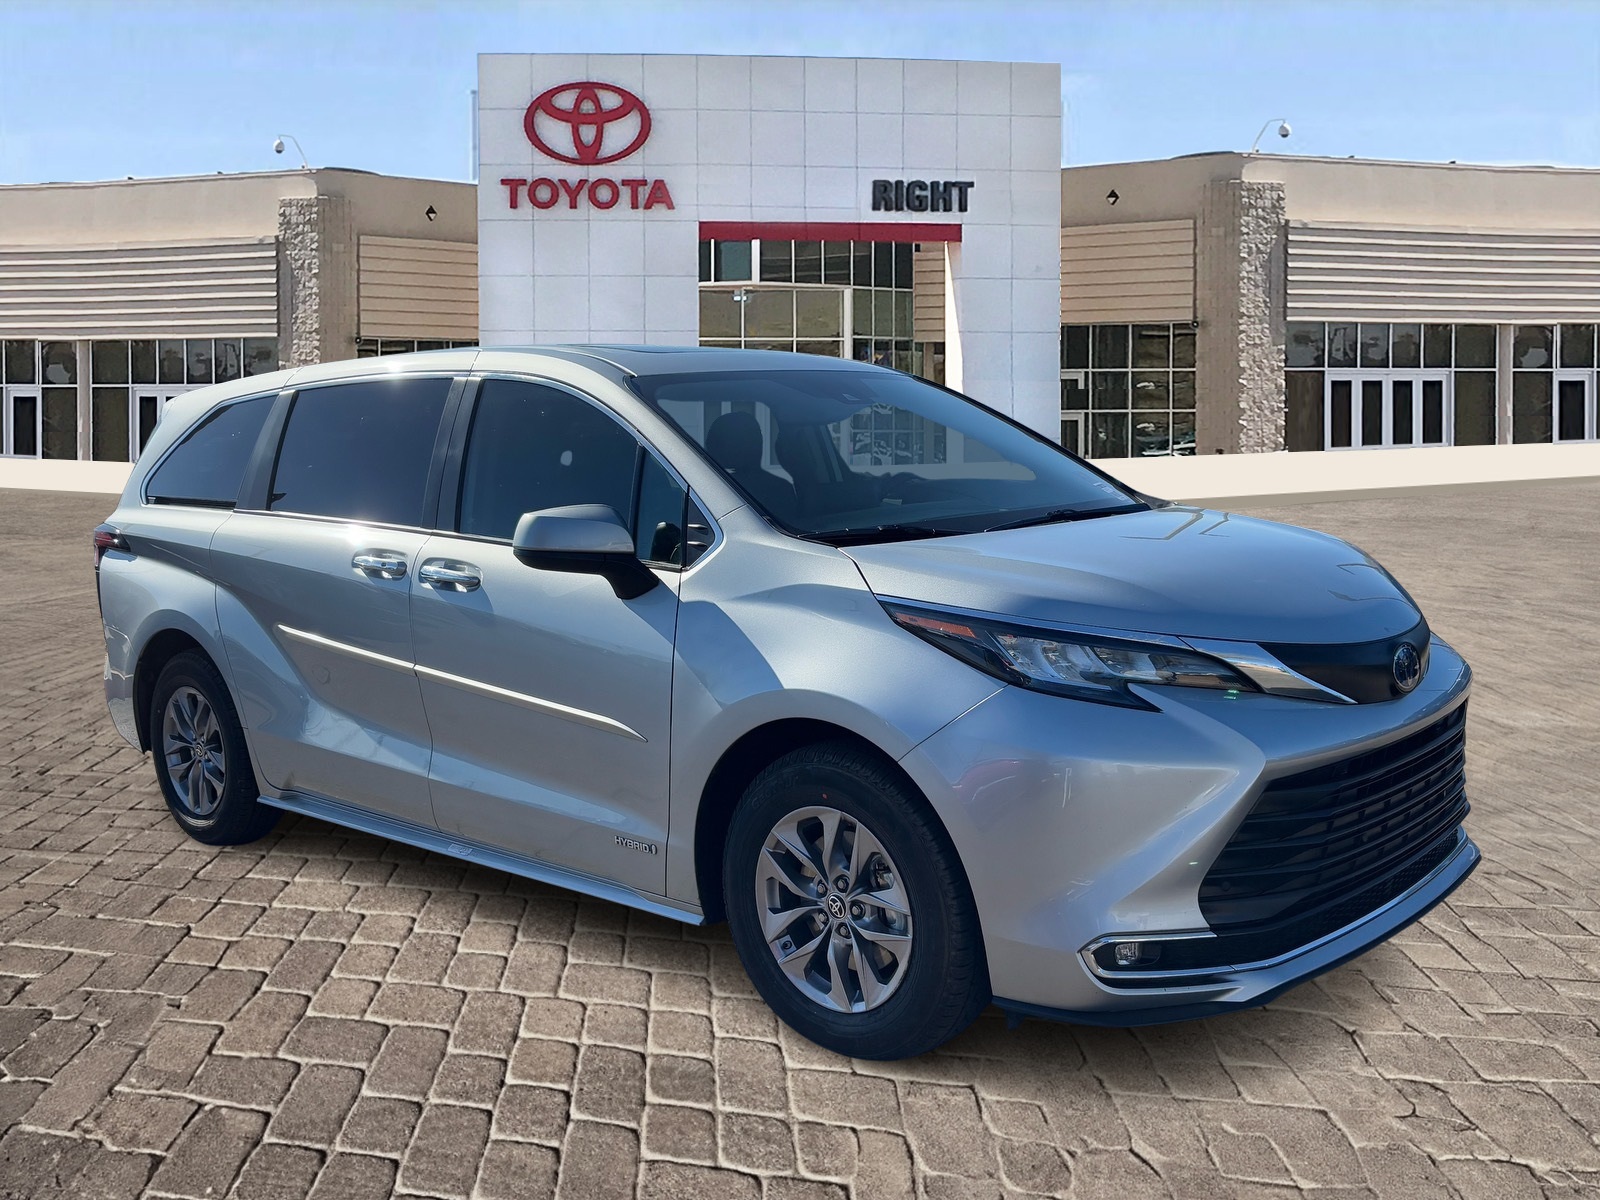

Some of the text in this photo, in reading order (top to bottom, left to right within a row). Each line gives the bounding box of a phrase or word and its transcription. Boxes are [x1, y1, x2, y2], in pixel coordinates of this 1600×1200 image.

[501, 178, 675, 209] TOYOTA
[872, 180, 975, 212] RIGHT
[614, 835, 650, 853] HYBRID
